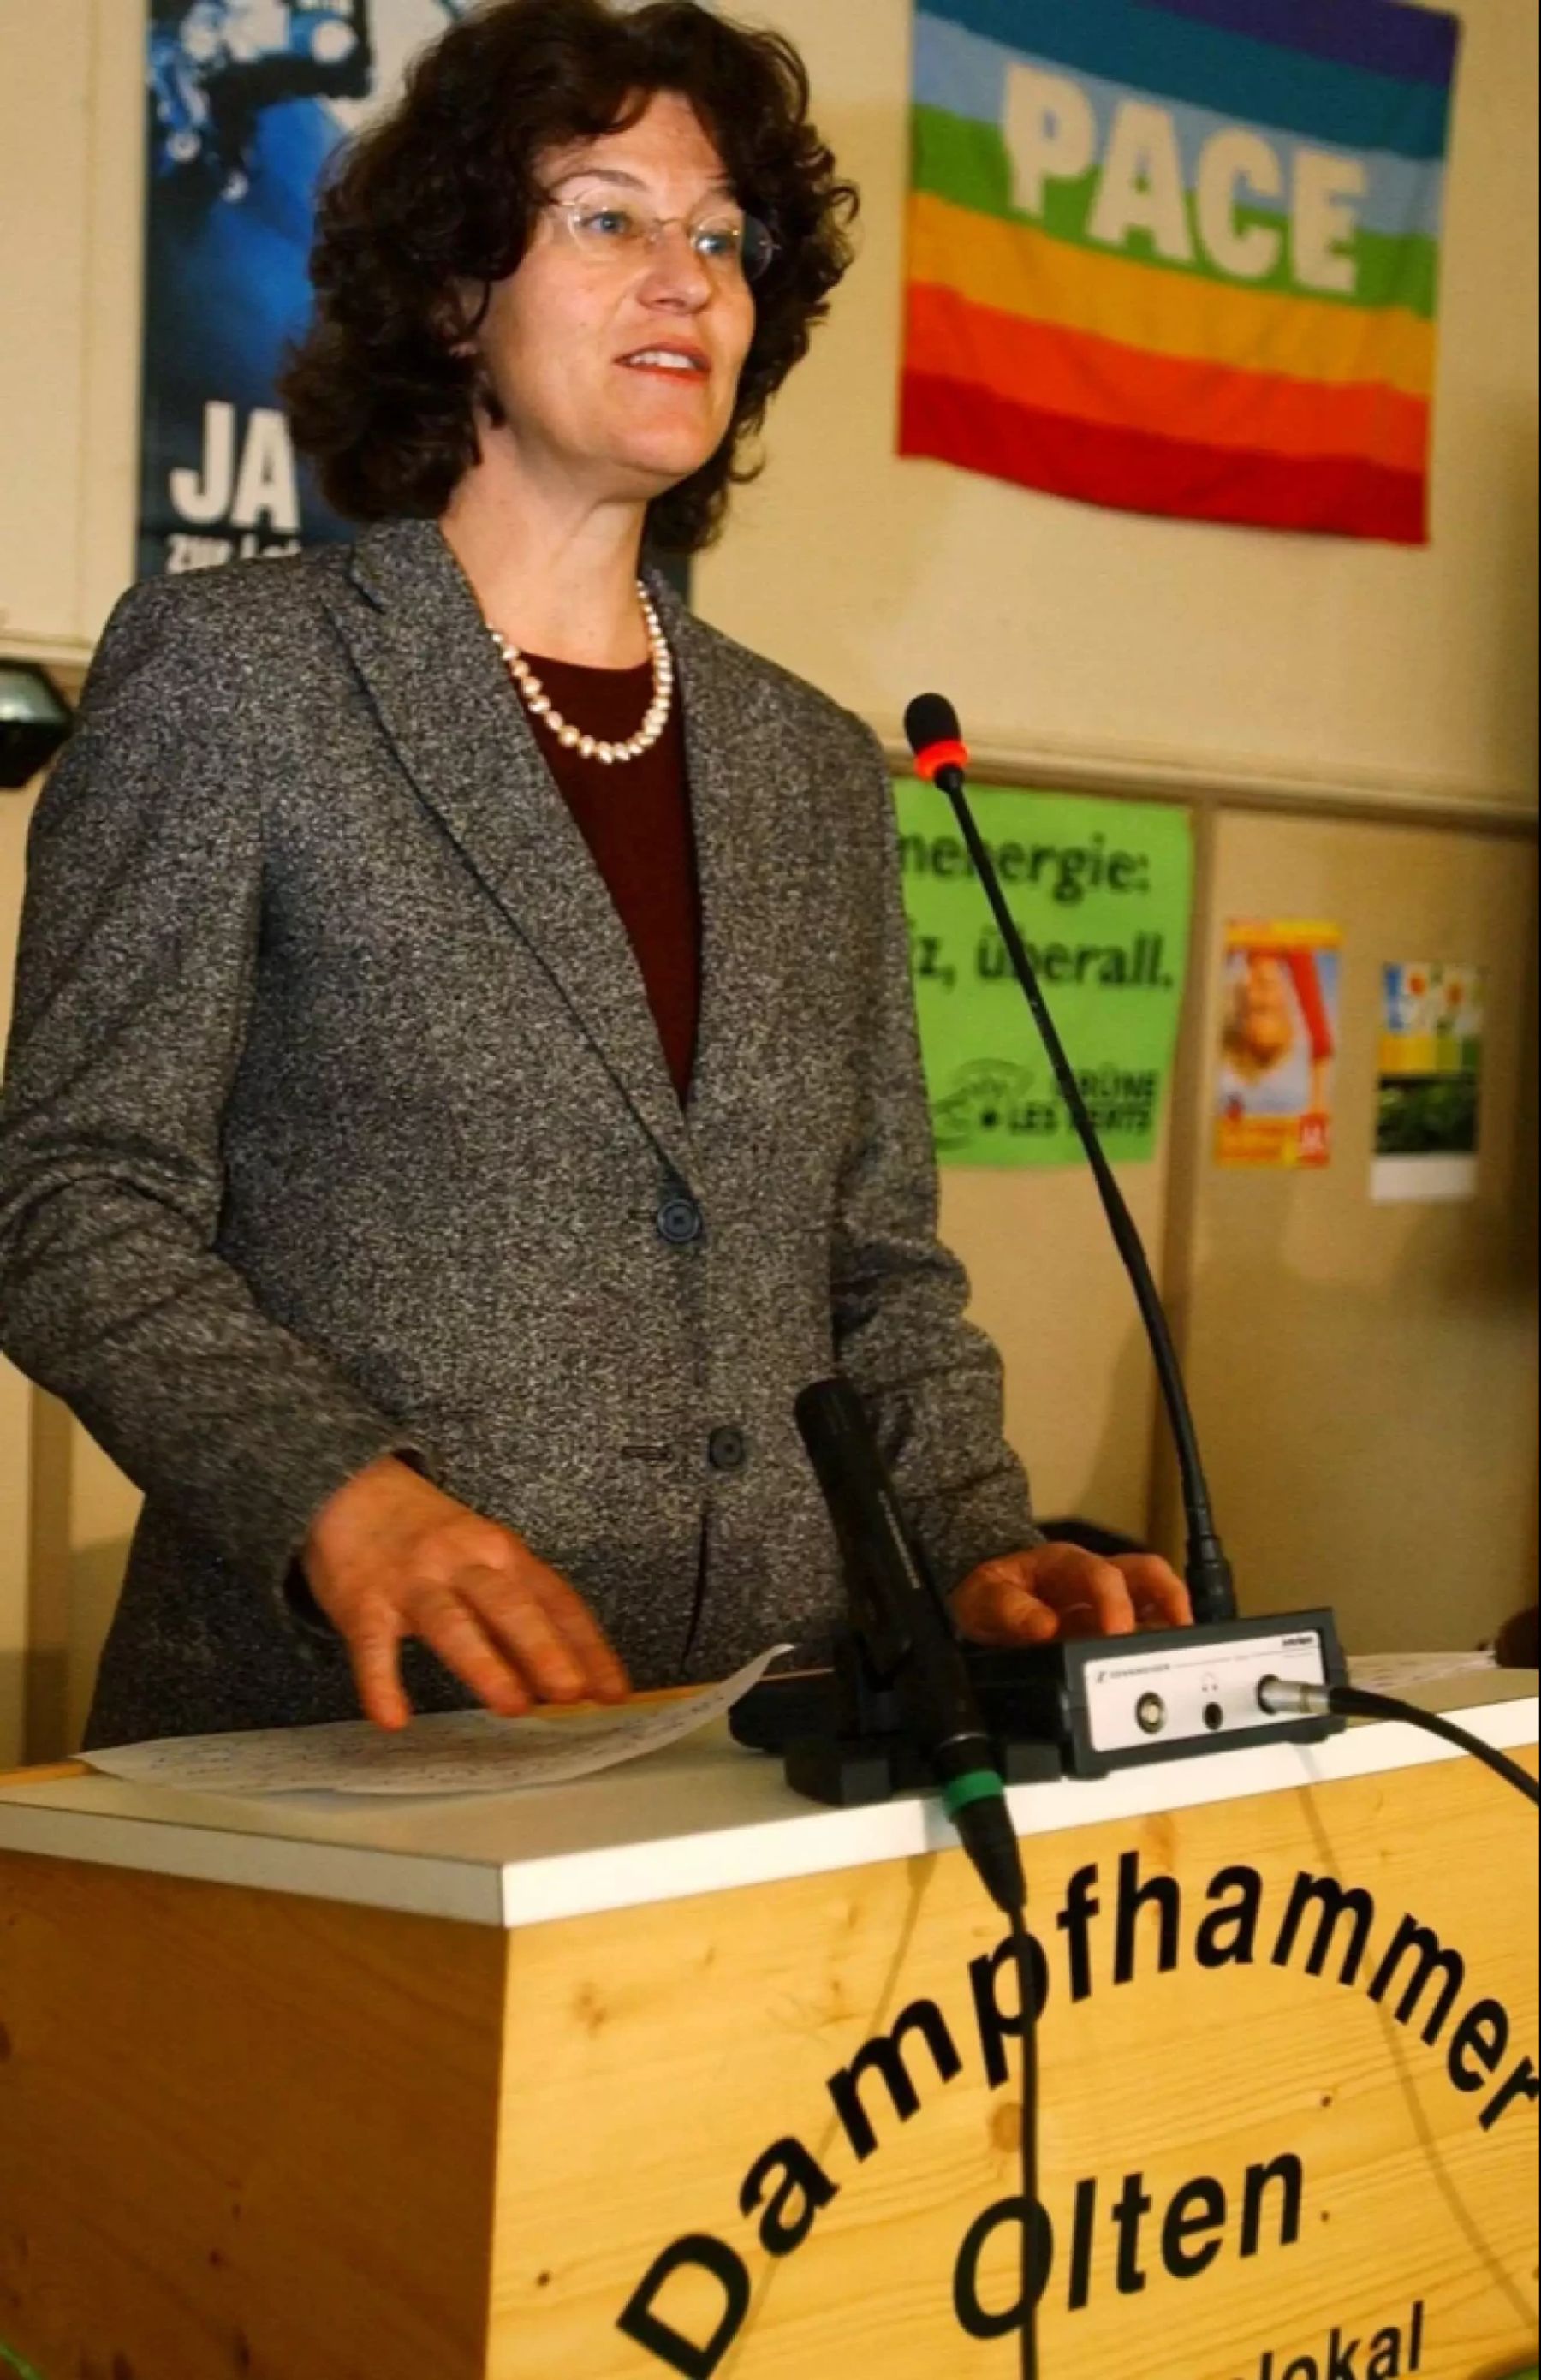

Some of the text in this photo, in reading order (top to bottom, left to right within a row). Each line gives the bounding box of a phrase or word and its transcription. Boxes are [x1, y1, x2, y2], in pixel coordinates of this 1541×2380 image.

[1000, 61, 1367, 294] PACE
[170, 398, 299, 533] JA
[1051, 1061, 1158, 1098] RÜNE
[616, 1851, 1539, 2380] Dampfhammer
[953, 2152, 1304, 2340] Olten
